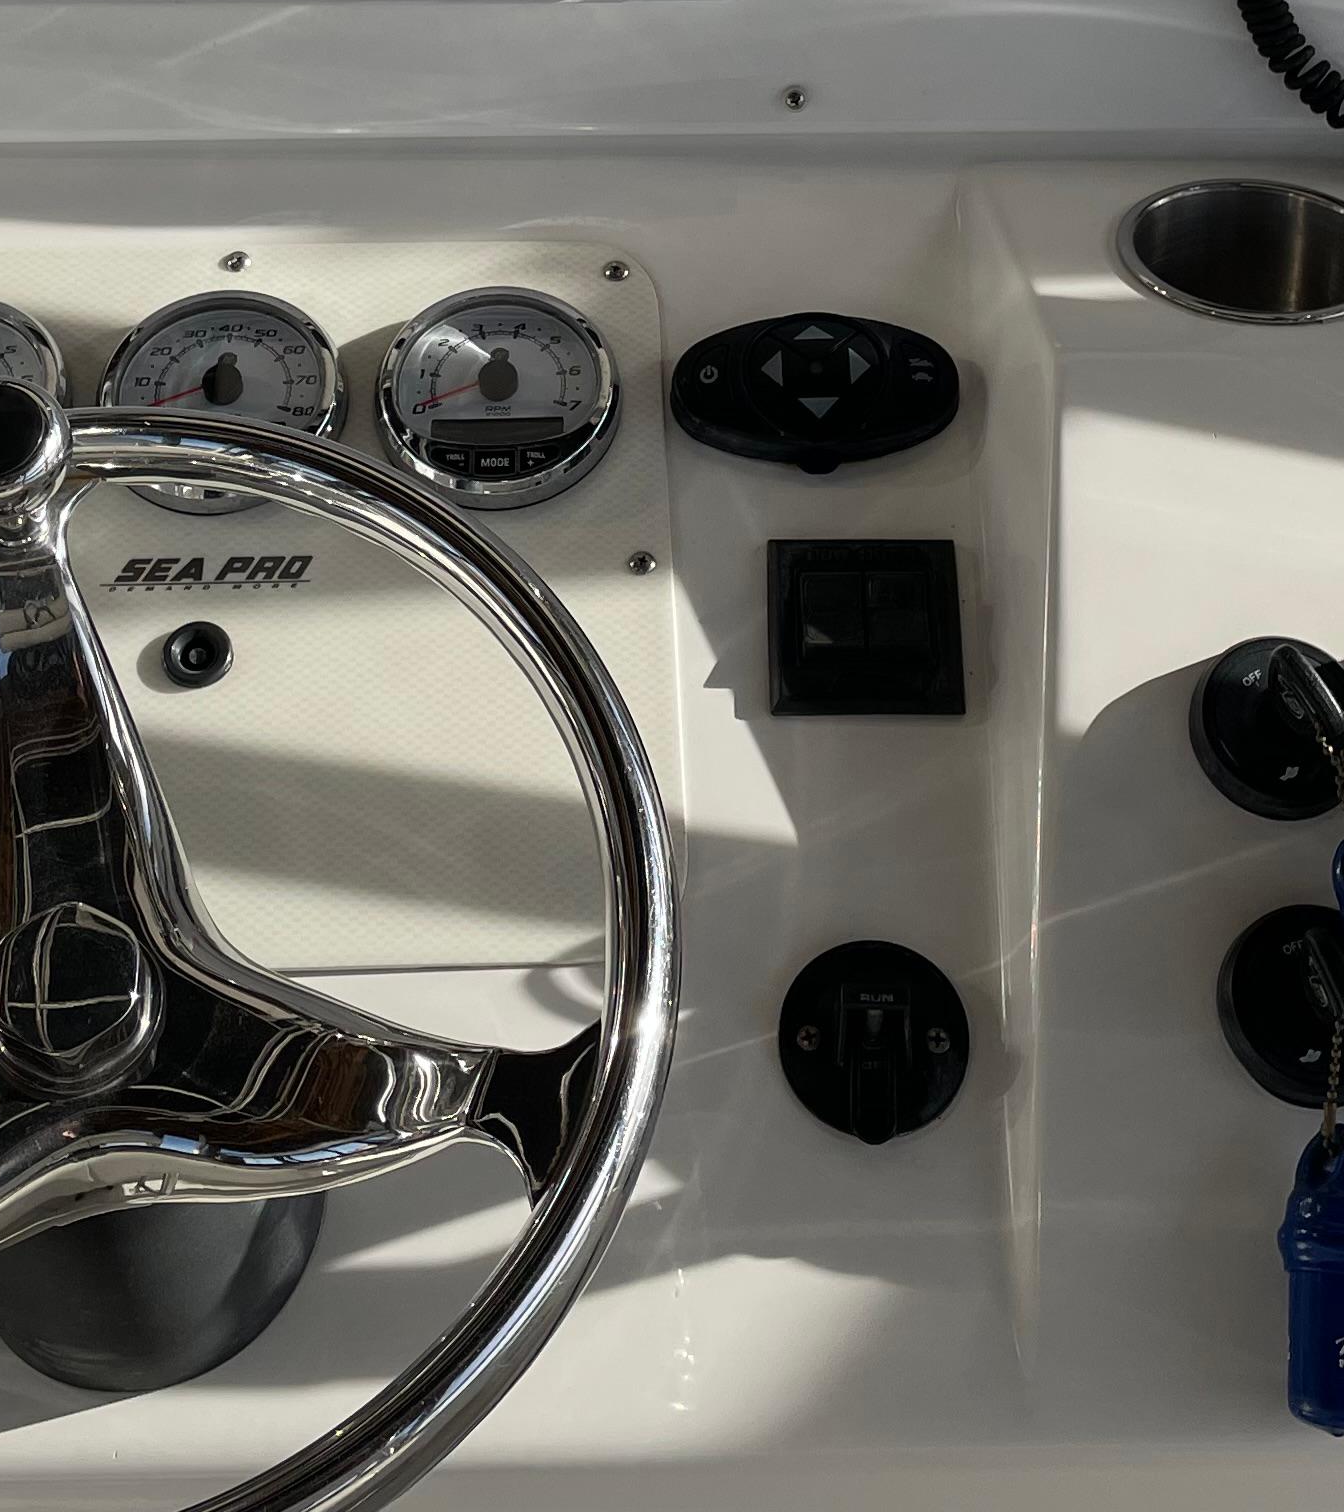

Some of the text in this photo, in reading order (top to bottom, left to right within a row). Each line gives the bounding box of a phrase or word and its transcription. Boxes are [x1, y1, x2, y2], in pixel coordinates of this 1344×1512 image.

[218, 324, 243, 333] 40
[254, 329, 278, 338] 50
[183, 330, 206, 338] 30
[550, 336, 562, 344] 5
[150, 348, 172, 356] 20
[283, 345, 306, 355] 60
[568, 366, 581, 376] 6
[135, 377, 151, 387] 10
[295, 375, 317, 385] 70
[412, 403, 426, 414] 0
[569, 400, 582, 411] 7
[292, 406, 313, 417] 80
[480, 458, 510, 467] MODE
[114, 555, 314, 583] SEA PRO
[1242, 669, 1262, 687] OFF
